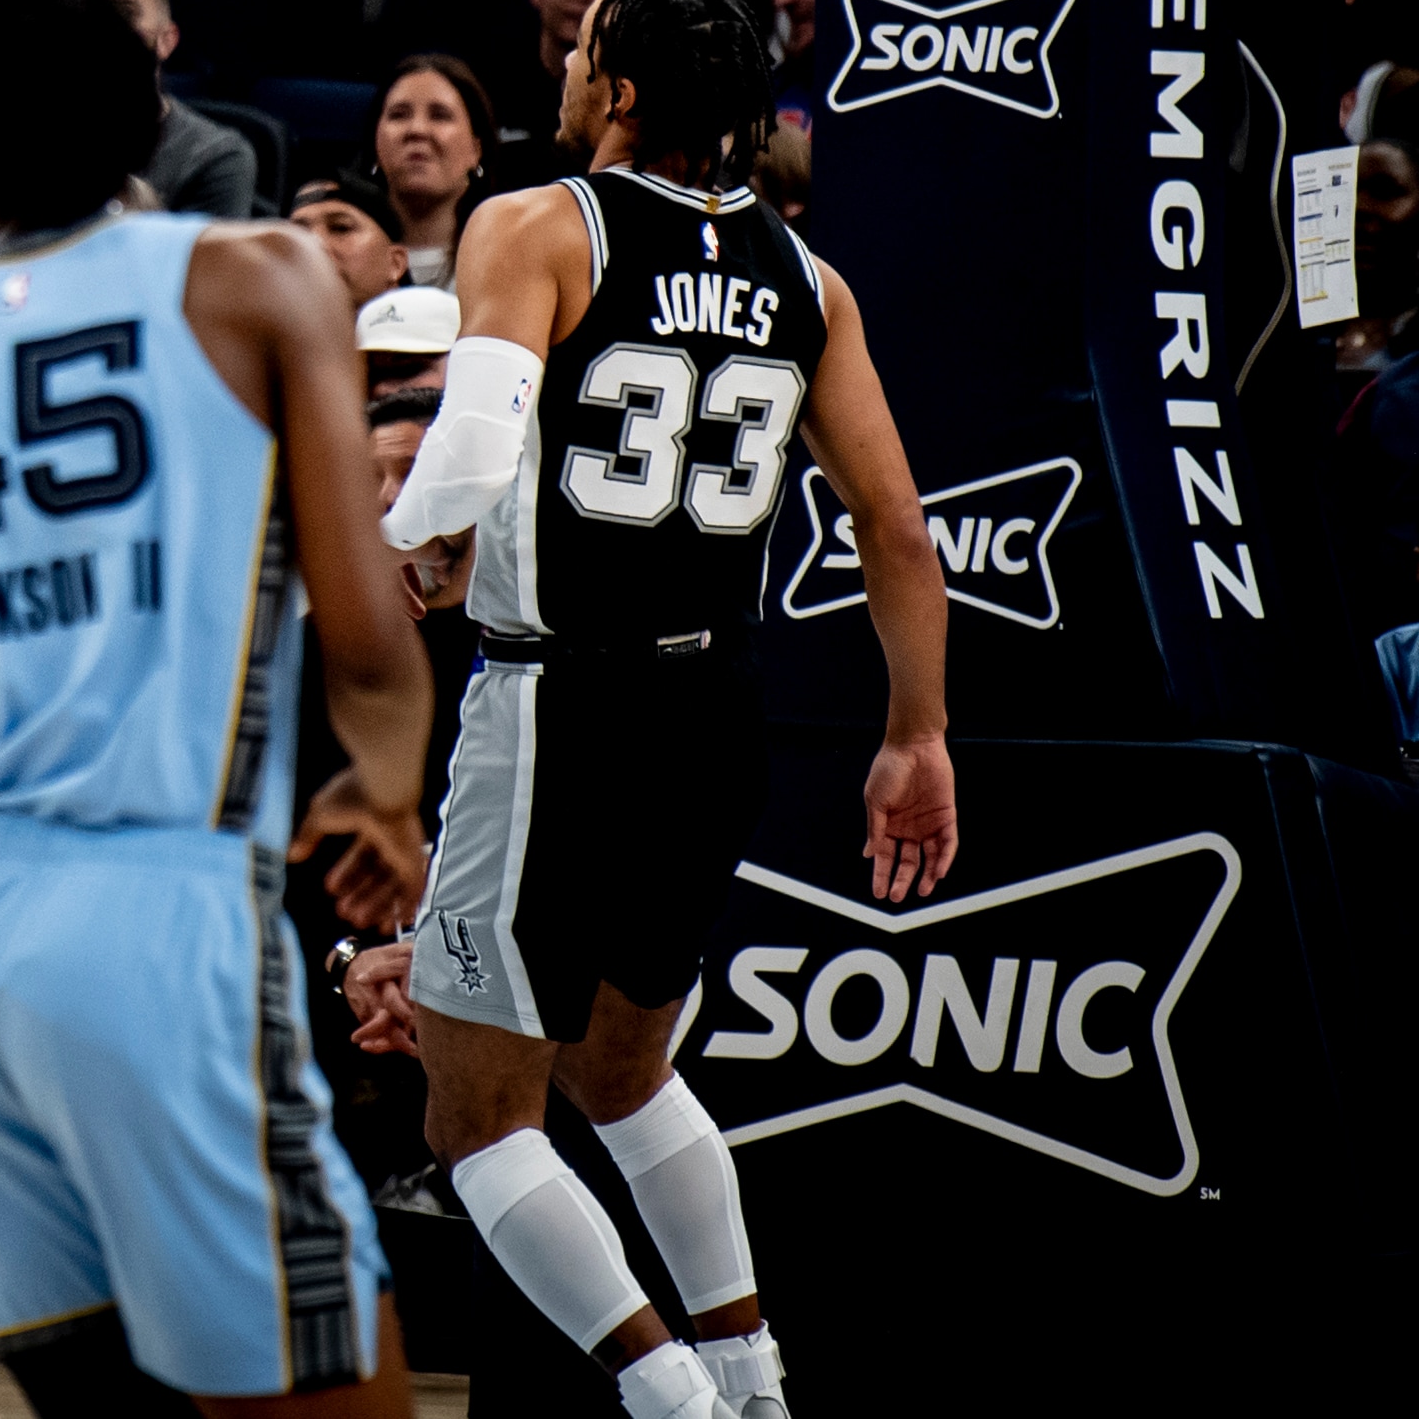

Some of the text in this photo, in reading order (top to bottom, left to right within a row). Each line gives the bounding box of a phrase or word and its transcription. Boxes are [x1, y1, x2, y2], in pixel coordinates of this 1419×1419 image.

[860, 24, 1039, 74] SONIC
[651, 272, 780, 347] JONES
[559, 342, 807, 535] 33
[821, 514, 1037, 575] SNIC
[702, 946, 1147, 1079] SONIC
[1200, 1186, 1221, 1201] SM
